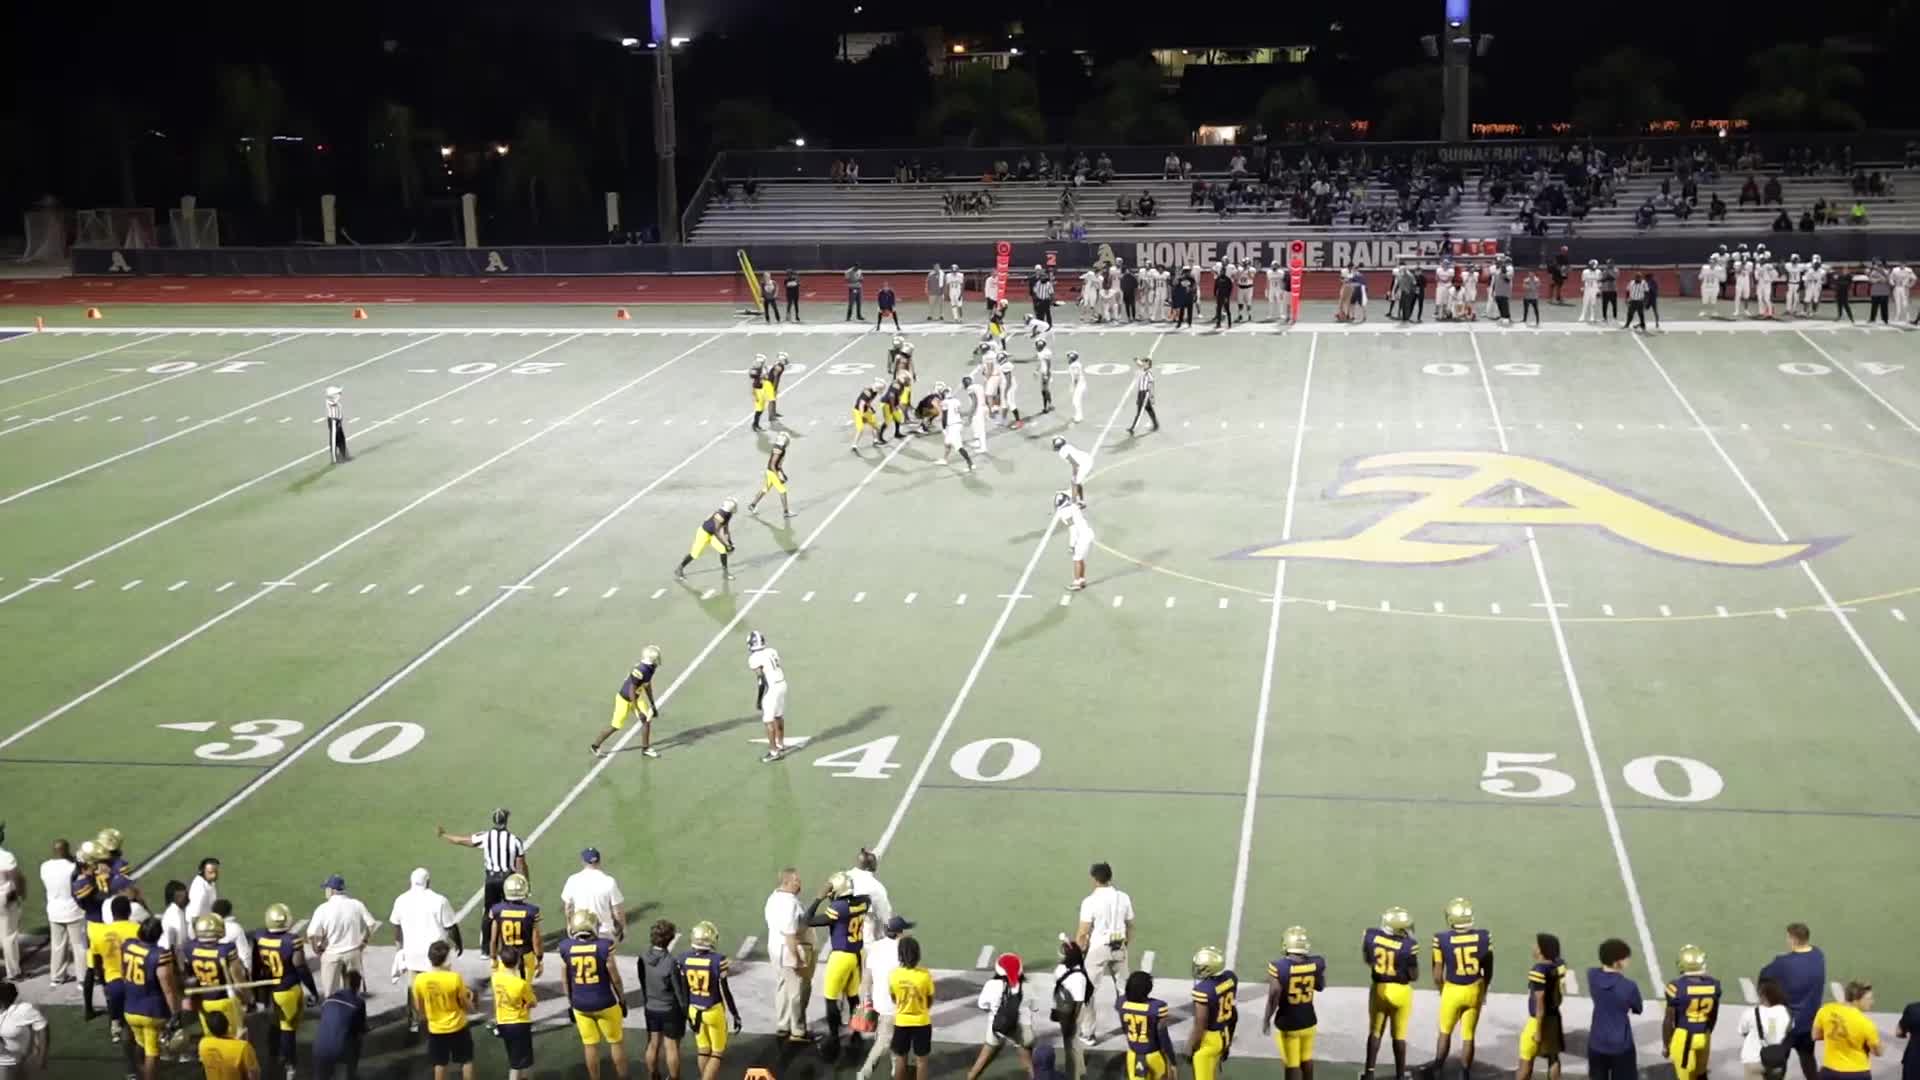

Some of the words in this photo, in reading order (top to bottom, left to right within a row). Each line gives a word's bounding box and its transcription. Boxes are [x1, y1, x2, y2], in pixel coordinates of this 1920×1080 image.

[1046, 254, 1057, 266] 2
[1136, 242, 1216, 267] HOME
[1226, 242, 1262, 267] OF
[1268, 242, 1324, 267] TE
[1332, 241, 1449, 267] RAIDER
[123, 952, 145, 986] 76
[570, 955, 600, 985] 72
[1373, 946, 1397, 976] 31
[1453, 946, 1480, 976] 15
[1288, 975, 1315, 1005] 53
[1685, 997, 1715, 1023] 42
[1123, 1014, 1149, 1043] 37
